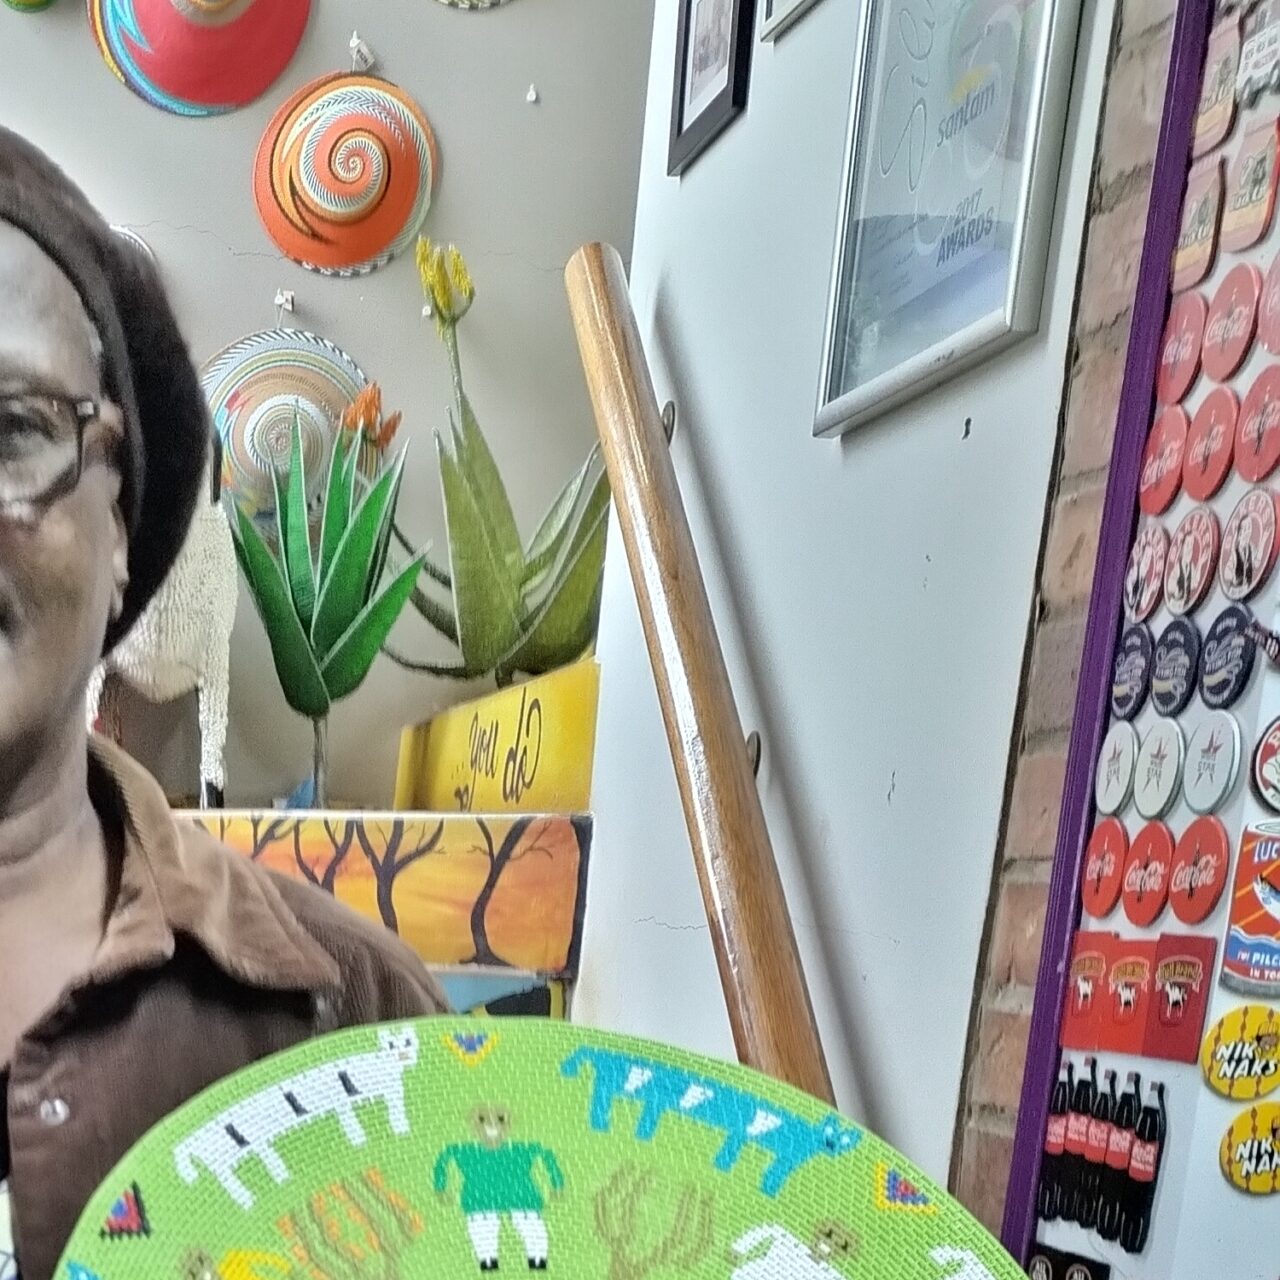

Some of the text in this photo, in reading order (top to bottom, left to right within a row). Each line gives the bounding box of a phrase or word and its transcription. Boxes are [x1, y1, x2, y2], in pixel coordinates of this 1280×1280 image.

[936, 84, 996, 147] santam
[954, 188, 983, 226] 2017
[936, 206, 994, 267] AWARDS
[1215, 1041, 1257, 1061] NIK
[1218, 1058, 1278, 1079] NAKS
[1235, 1137, 1273, 1162] NIK
